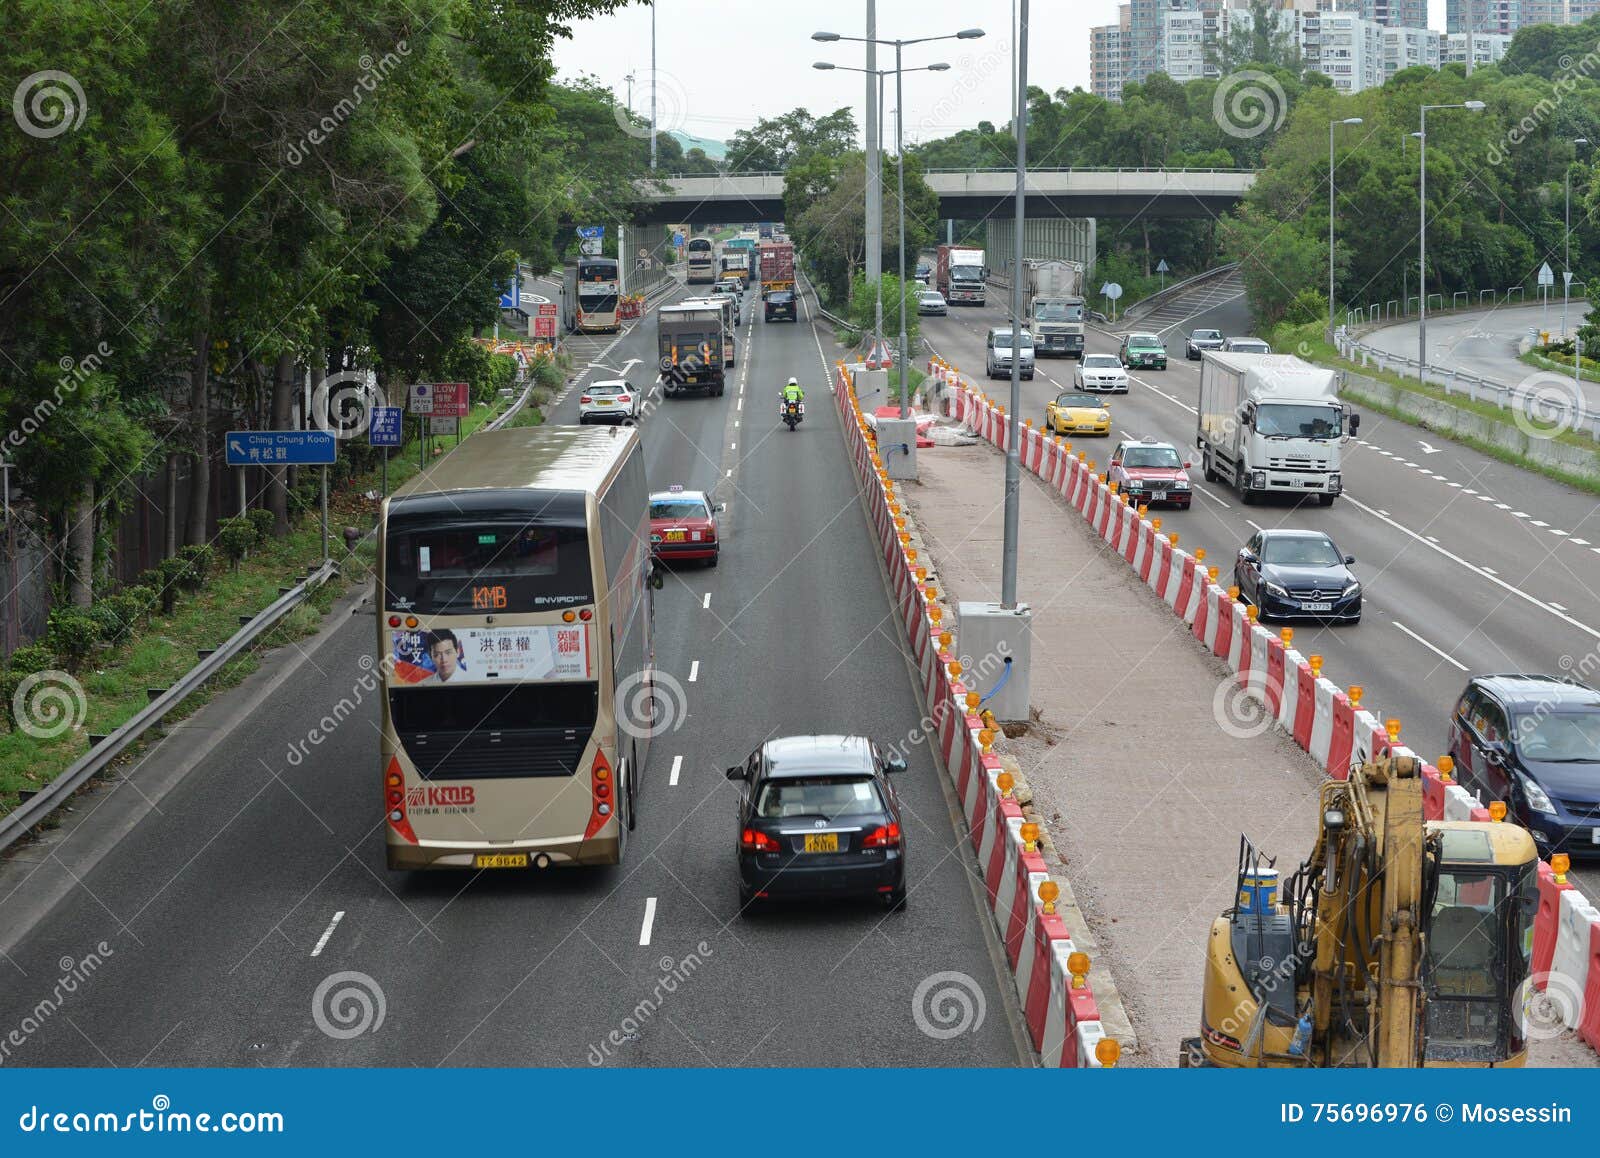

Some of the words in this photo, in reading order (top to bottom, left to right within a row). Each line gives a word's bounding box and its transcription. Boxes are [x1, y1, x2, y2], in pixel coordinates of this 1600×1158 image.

[249, 435, 273, 446] Ching
[276, 435, 304, 445] Chung
[307, 434, 330, 444] Koon
[249, 447, 287, 459] 青松觀
[472, 586, 508, 609] KMB
[480, 636, 531, 652] 洪偉權
[428, 785, 475, 806] KMB
